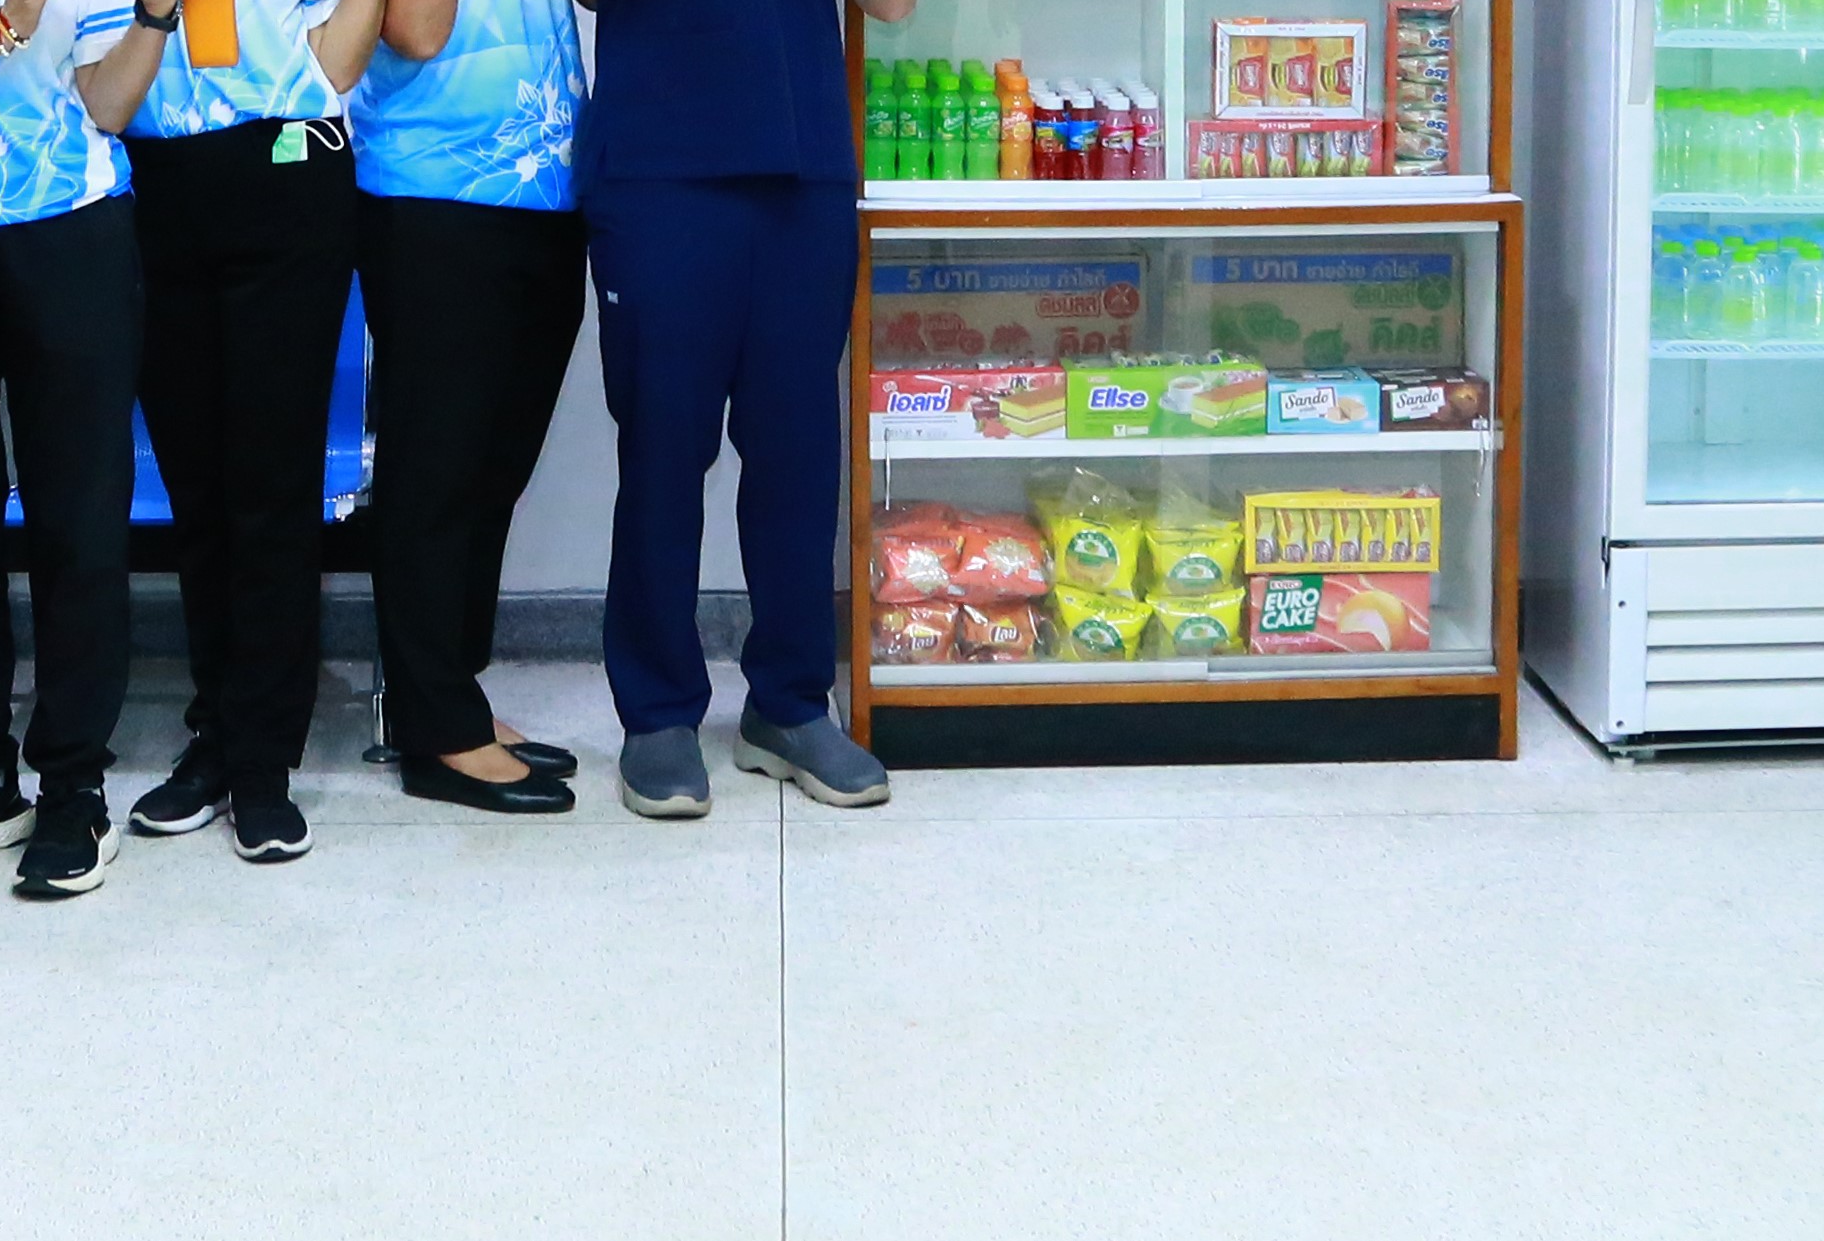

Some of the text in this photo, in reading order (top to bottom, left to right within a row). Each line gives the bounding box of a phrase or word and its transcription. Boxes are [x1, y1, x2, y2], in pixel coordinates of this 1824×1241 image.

[907, 271, 922, 290] 5
[933, 270, 981, 290] บาท
[1226, 261, 1241, 280] 5
[1252, 260, 1299, 280] บาท
[1284, 391, 1329, 409] Sando
[1396, 390, 1440, 408] Sando
[1265, 588, 1320, 611] EURO
[1262, 607, 1315, 629] CAKE
